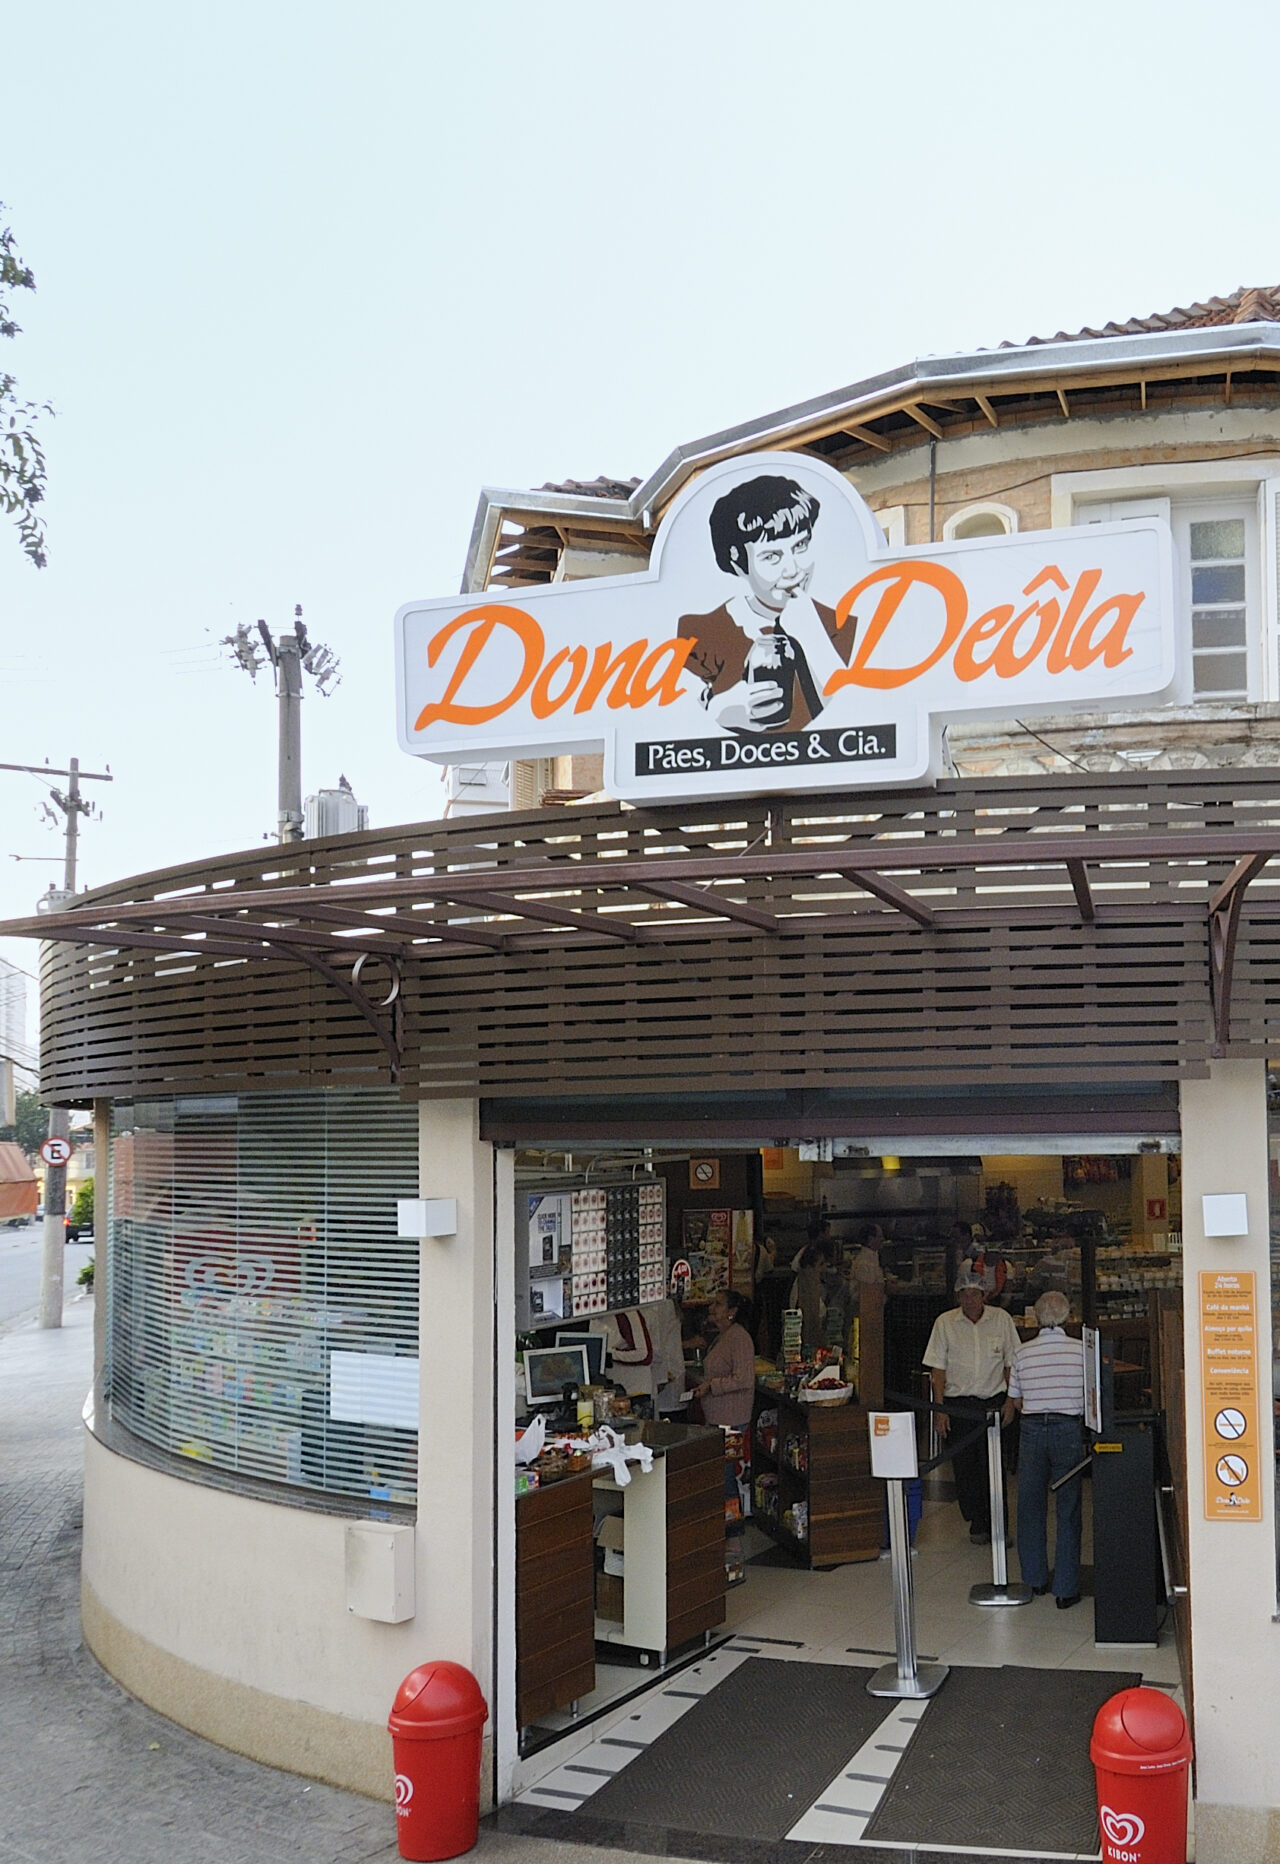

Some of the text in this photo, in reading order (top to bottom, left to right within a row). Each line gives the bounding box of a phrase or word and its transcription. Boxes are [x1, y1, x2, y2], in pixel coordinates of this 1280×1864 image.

[415, 560, 1145, 731] Dona Deôla
[648, 730, 887, 770] Pães, Doces & Cia.
[1107, 1845, 1137, 1862] KIBON
